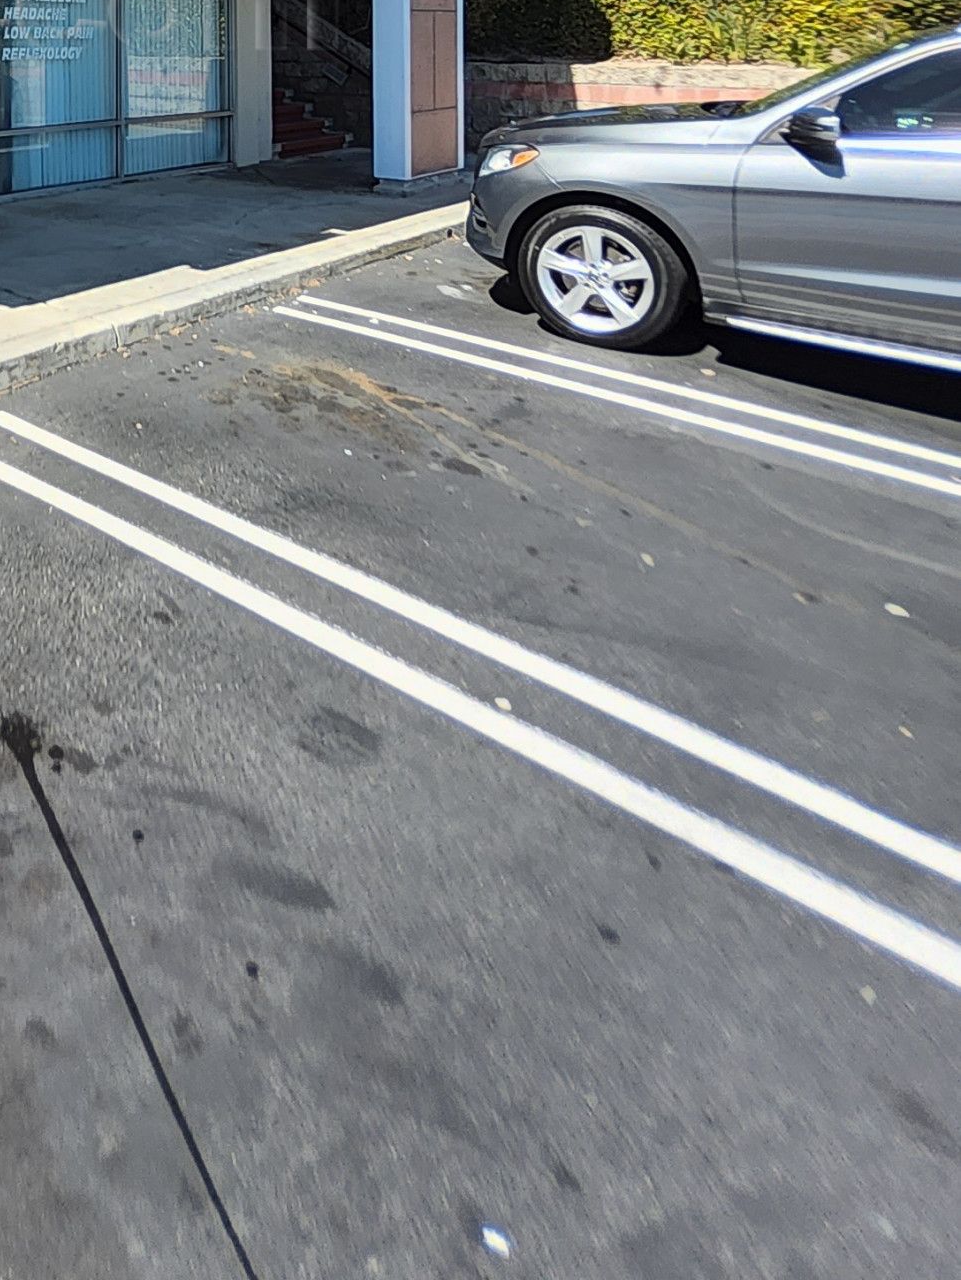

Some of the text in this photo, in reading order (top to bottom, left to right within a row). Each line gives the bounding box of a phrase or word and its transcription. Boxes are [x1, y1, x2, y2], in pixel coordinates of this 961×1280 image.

[3, 6, 67, 21] HEADACHE
[3, 26, 30, 40] LOW
[33, 26, 64, 40] BACK
[1, 46, 83, 61] REFLEXOLOGY
